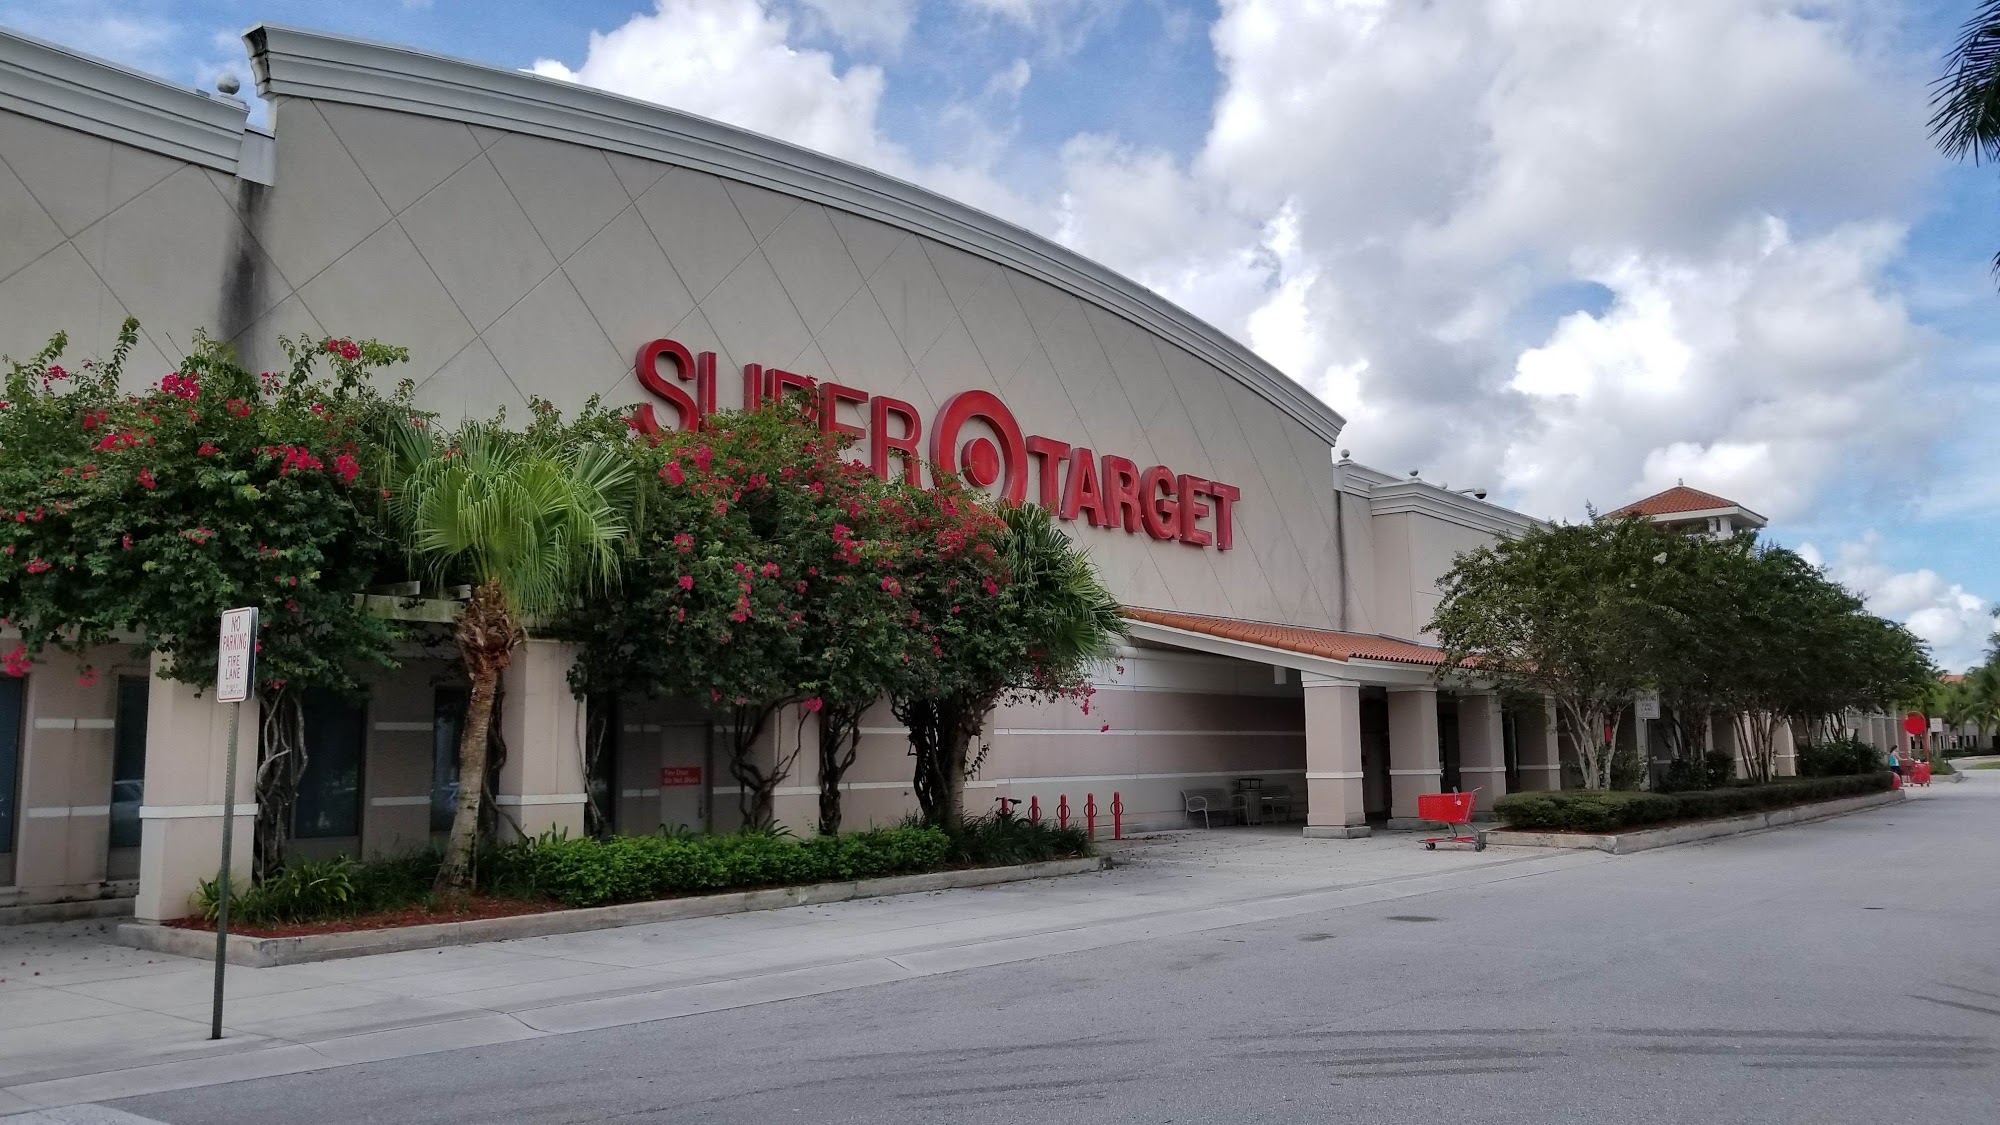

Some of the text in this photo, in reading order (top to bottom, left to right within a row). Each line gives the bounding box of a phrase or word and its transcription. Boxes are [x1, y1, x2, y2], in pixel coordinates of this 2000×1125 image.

[1026, 435, 1241, 551] TARGET
[231, 616, 241, 632] NO
[223, 632, 247, 652] PARKING
[227, 655, 241, 667] FIRE
[225, 667, 241, 680] LANE
